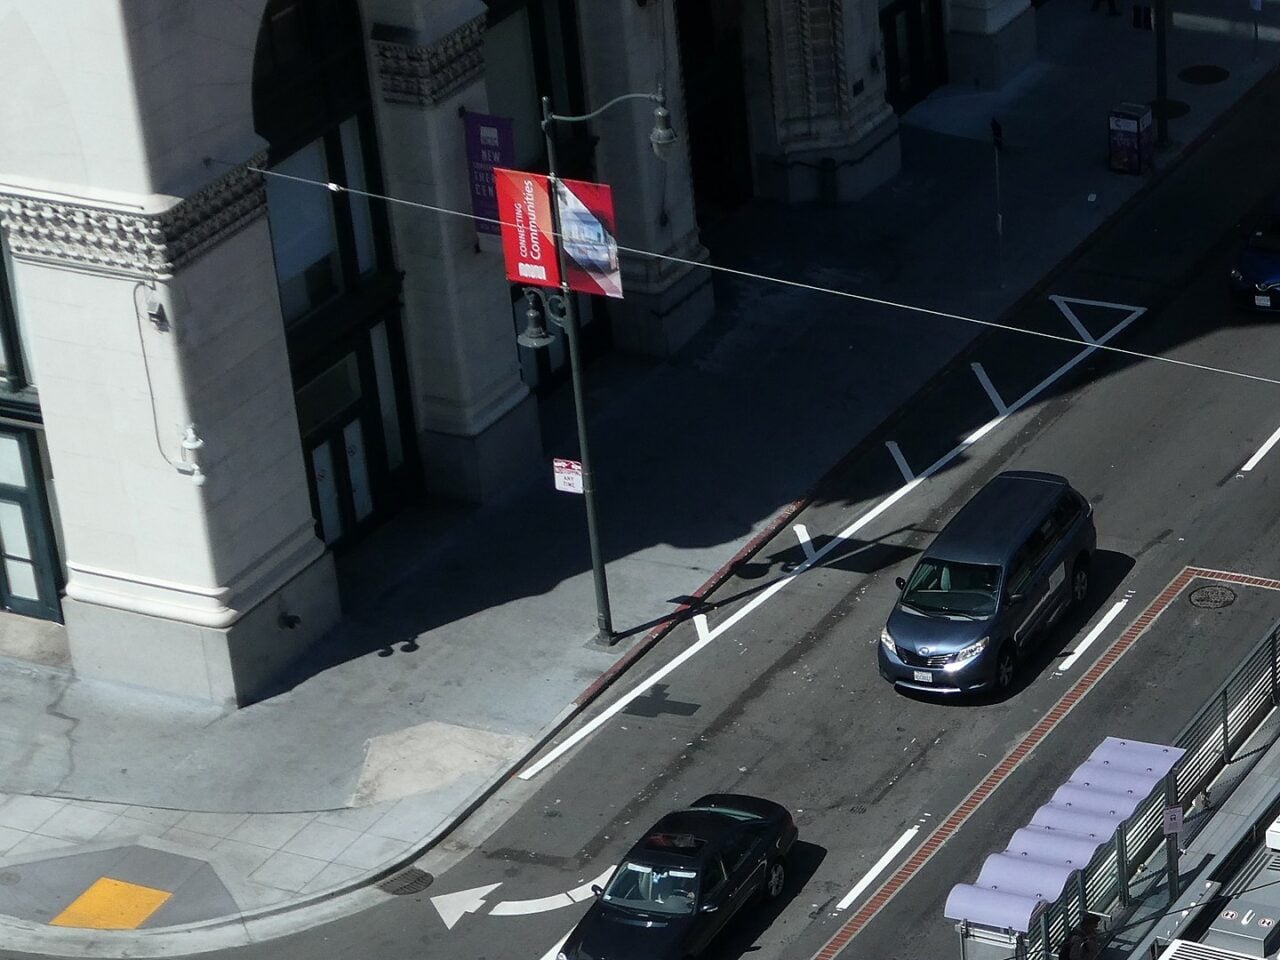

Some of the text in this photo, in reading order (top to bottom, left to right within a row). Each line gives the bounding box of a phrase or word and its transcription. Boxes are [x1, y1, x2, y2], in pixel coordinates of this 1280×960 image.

[481, 150, 500, 162] NEW
[514, 202, 528, 258] CONNECTING
[523, 179, 541, 261] Communities
